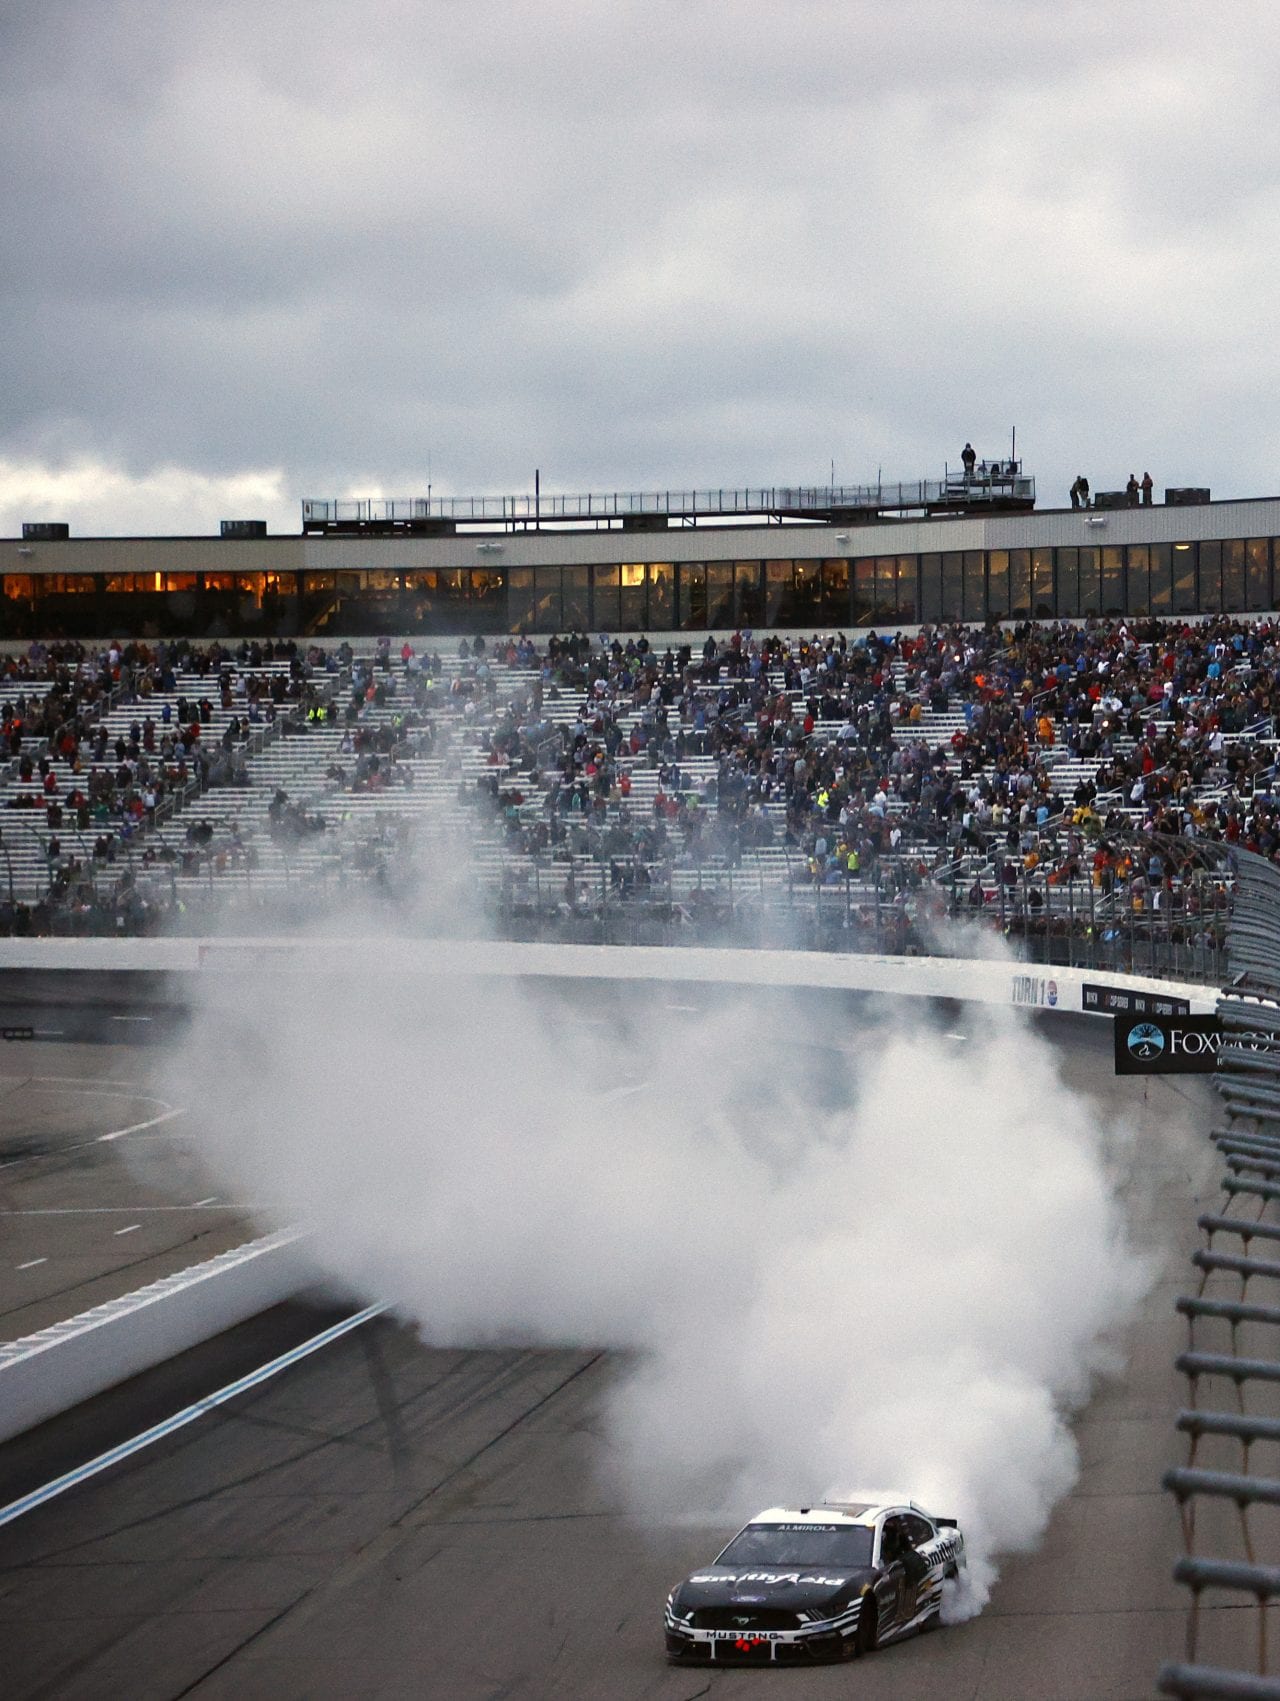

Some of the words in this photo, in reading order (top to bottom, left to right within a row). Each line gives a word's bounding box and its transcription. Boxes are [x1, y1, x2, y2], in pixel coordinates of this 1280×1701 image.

[1012, 975, 1038, 1004] TURN
[1041, 978, 1046, 1006] 1
[777, 1524, 837, 1532] ALMIROLA
[689, 1572, 846, 1588] Smithfield
[706, 1631, 779, 1640] MUSTANG
